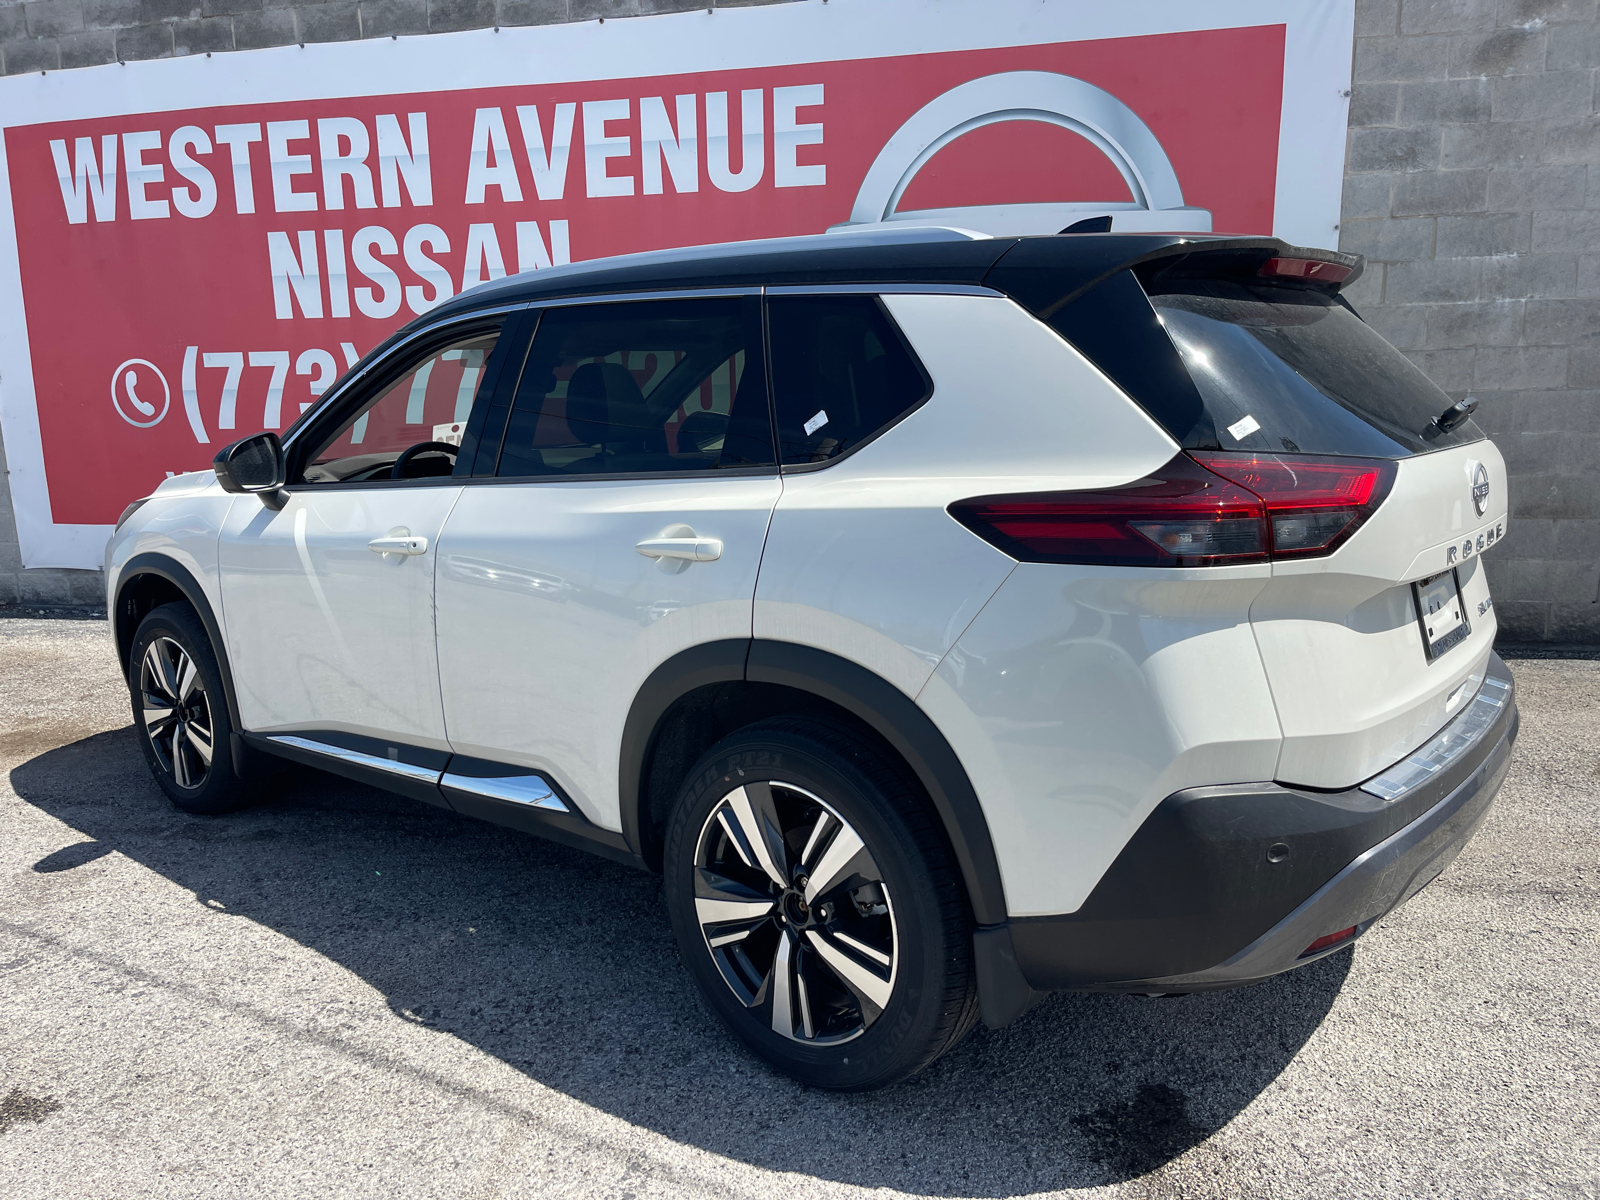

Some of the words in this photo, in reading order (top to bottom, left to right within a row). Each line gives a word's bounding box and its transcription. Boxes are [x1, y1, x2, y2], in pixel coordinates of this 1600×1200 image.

[49, 111, 434, 225] WESTERN
[464, 83, 827, 205] AVENUE
[1446, 523, 1503, 566] ROGUE
